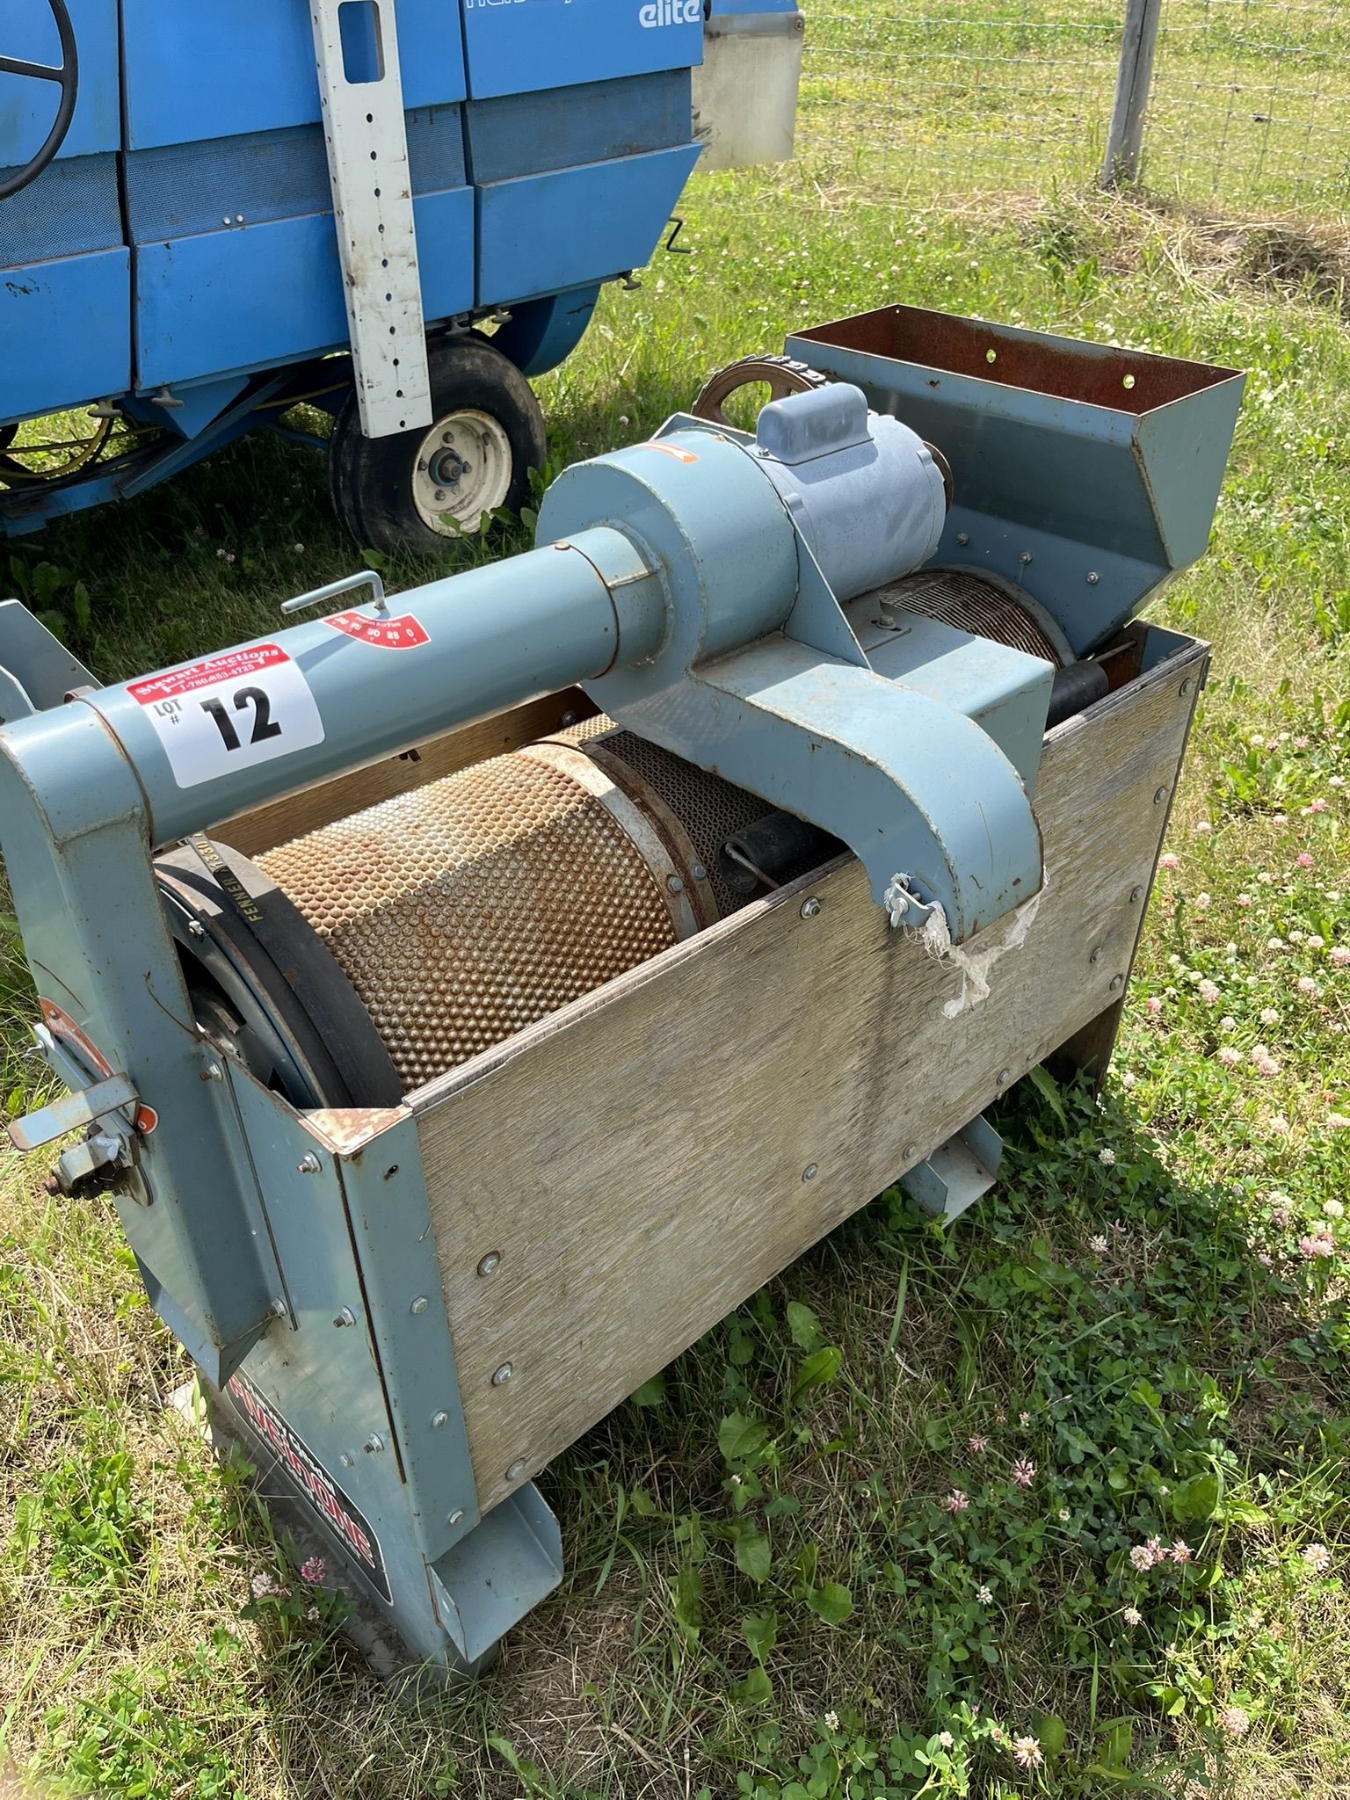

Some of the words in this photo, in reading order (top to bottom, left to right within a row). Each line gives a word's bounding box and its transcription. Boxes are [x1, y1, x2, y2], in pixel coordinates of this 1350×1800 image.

[639, 0, 700, 28] elite
[135, 667, 200, 695] Stewart
[203, 648, 279, 670] Auctions
[153, 699, 183, 717] LOT
[169, 714, 181, 725] #
[199, 686, 283, 752] 12
[222, 878, 264, 922] FENNER
